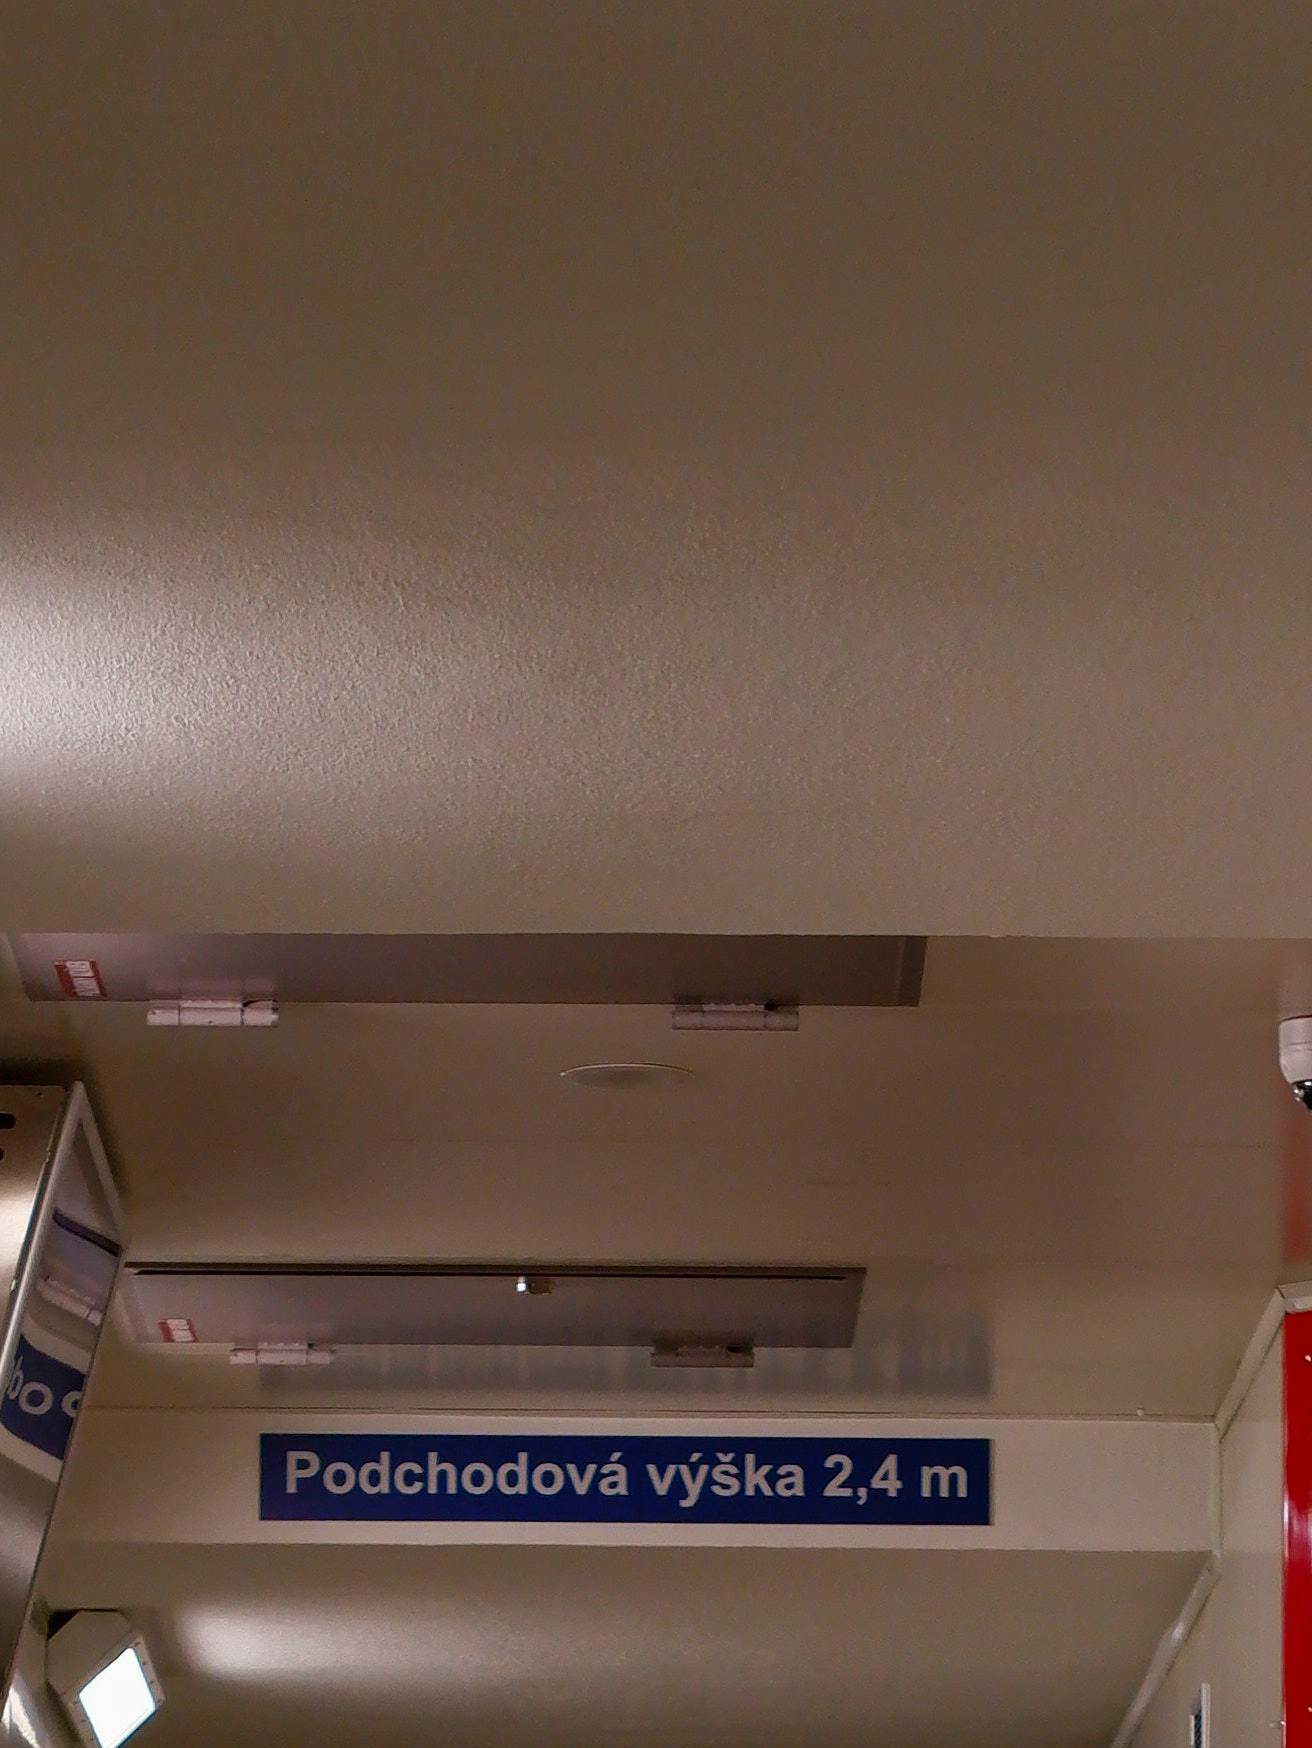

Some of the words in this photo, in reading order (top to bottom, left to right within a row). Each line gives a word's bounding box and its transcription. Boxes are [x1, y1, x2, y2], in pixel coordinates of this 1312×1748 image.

[285, 1450, 630, 1497] Podchodová
[645, 1451, 806, 1508] výška
[822, 1453, 904, 1505] 2,4
[919, 1464, 968, 1499] m
